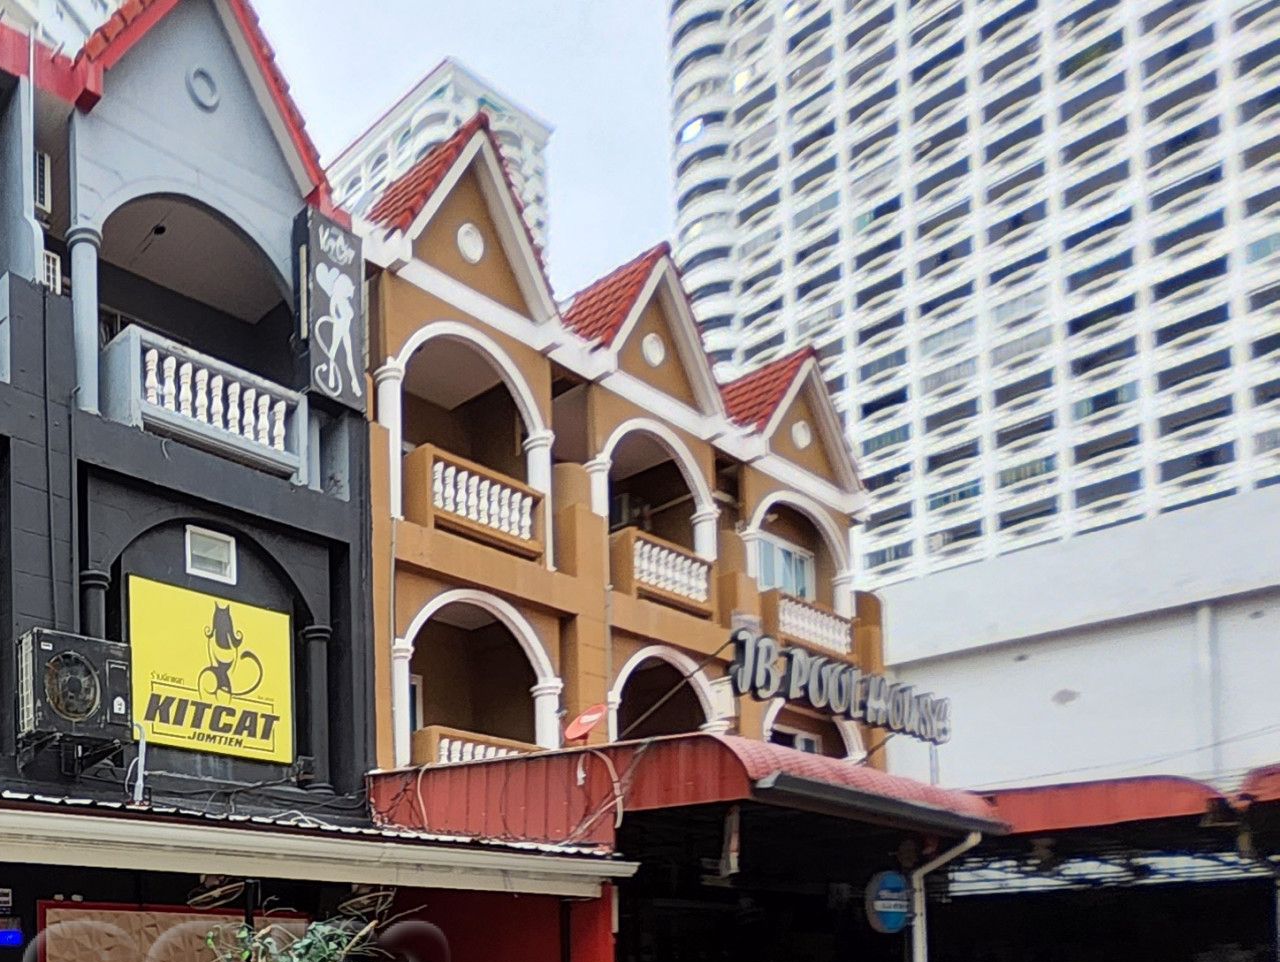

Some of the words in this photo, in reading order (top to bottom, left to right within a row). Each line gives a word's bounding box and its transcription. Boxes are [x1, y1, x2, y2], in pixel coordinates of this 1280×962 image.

[144, 693, 280, 741] KITCAT
[786, 648, 864, 718] POOL
[865, 675, 951, 743] HOUSE
[187, 731, 243, 748] JOMTIEN
